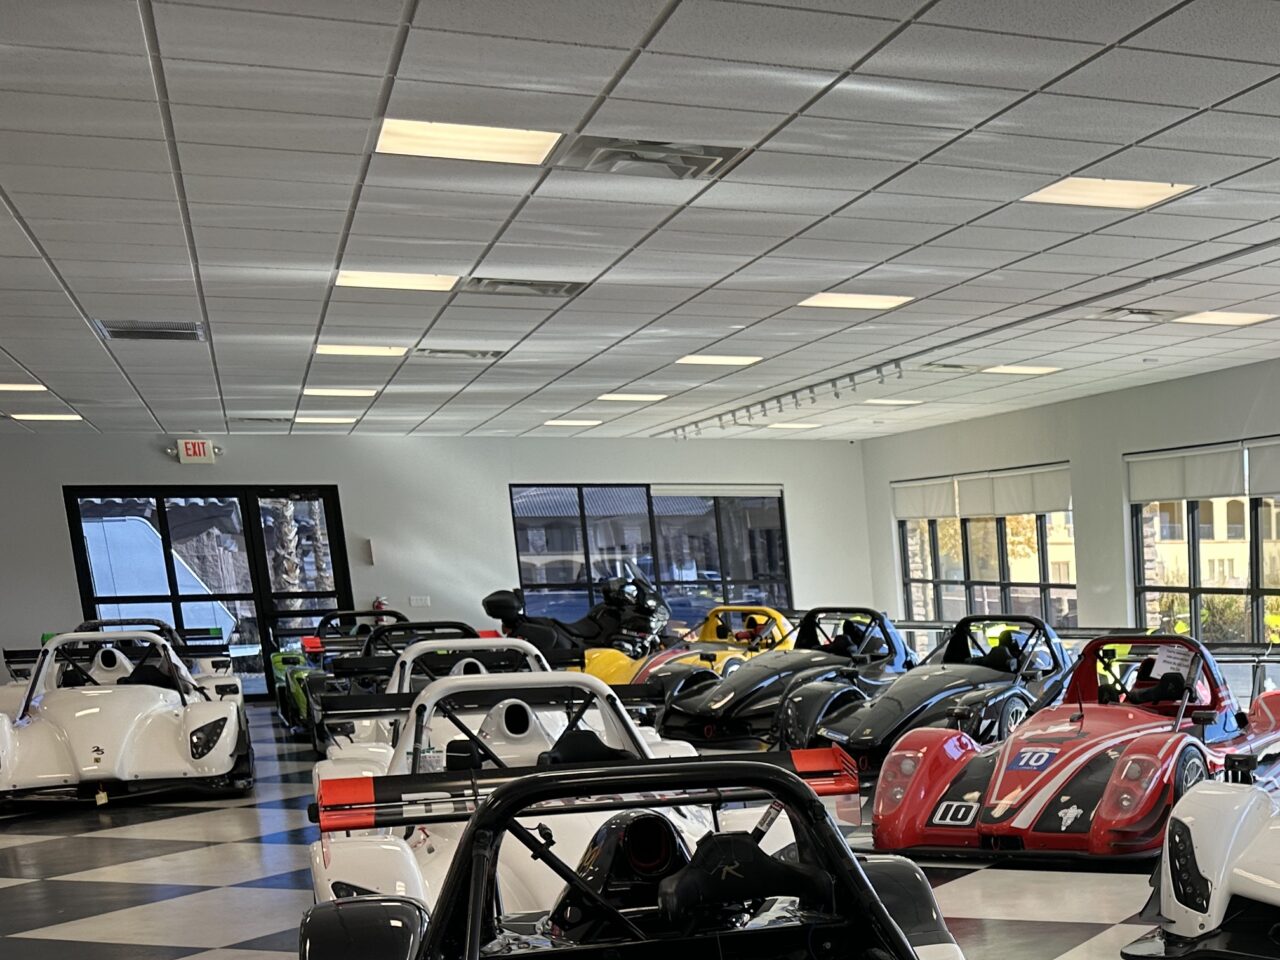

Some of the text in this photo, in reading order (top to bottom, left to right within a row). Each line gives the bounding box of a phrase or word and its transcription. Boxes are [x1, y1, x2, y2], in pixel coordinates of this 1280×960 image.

[184, 441, 207, 457] EXIT
[1018, 752, 1050, 766] 10
[939, 804, 971, 822] 10
